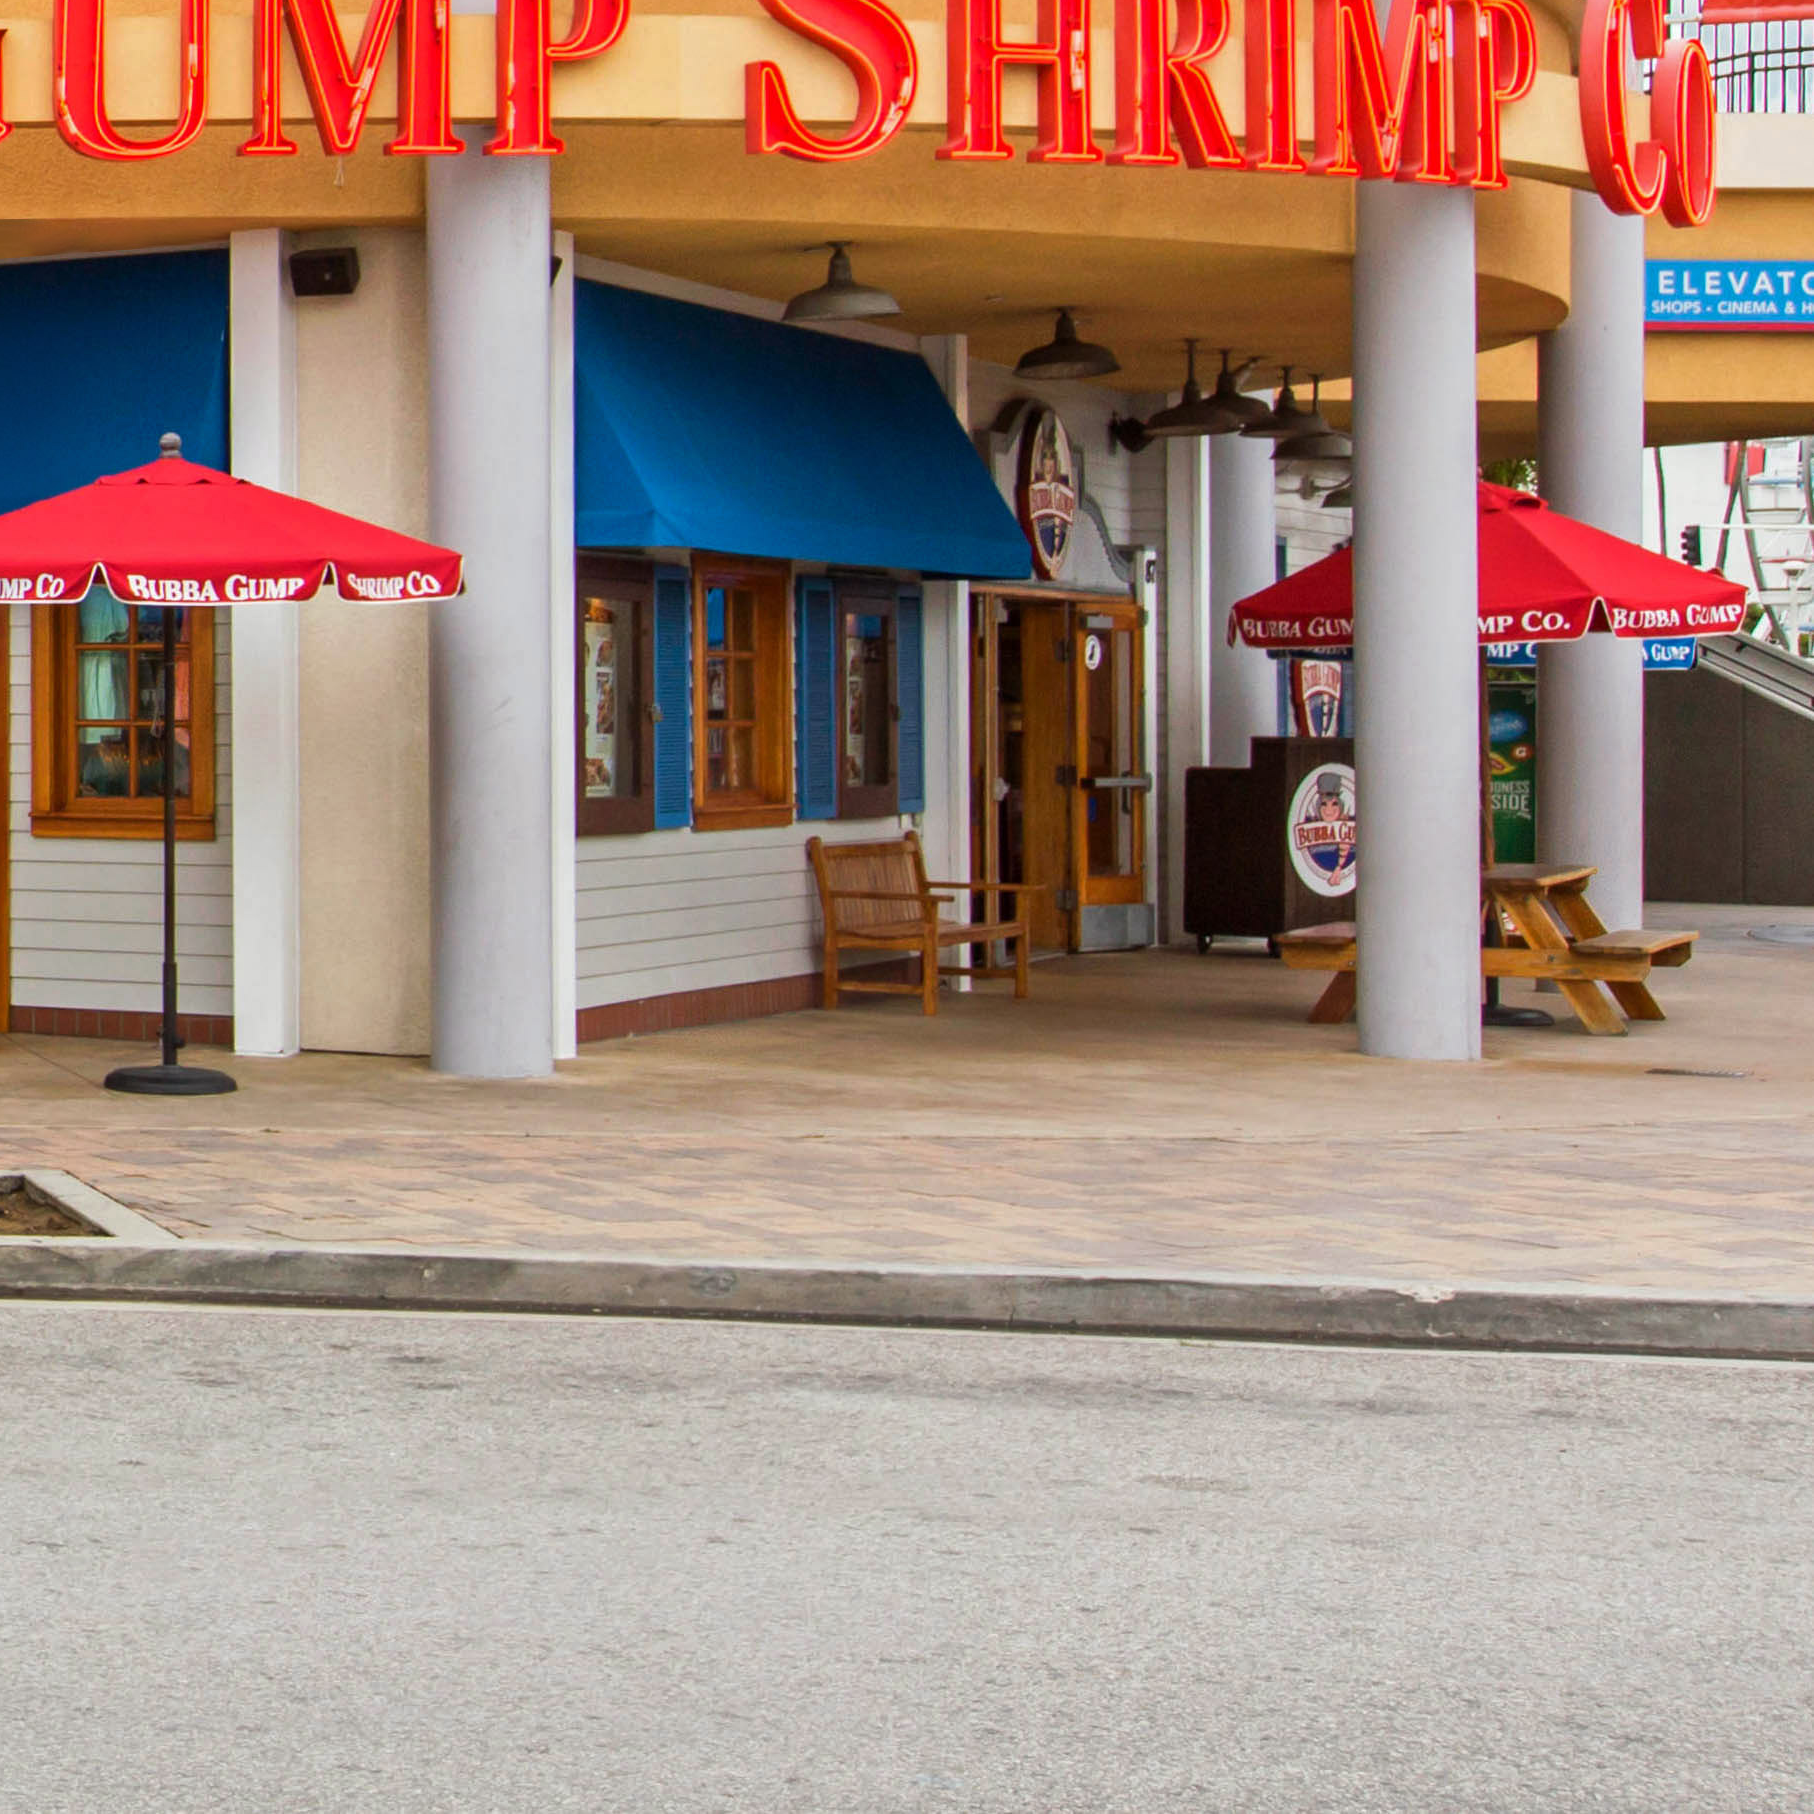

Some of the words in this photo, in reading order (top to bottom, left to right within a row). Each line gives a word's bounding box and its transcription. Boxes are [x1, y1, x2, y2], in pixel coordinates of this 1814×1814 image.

[1651, 300, 1702, 314] SHOPS
[1718, 300, 1778, 314] CINEMA
[1784, 301, 1796, 314] &
[127, 575, 220, 602] BUBBA
[224, 574, 305, 601] GUMP
[347, 572, 404, 599] SHRIMP
[1242, 618, 1302, 639] BUBBA
[1307, 616, 1354, 638] GUM
[1521, 610, 1571, 632] CO.
[1613, 607, 1680, 629] BUBBA
[1685, 603, 1743, 626] GUMP
[1297, 824, 1336, 844] BUBBA
